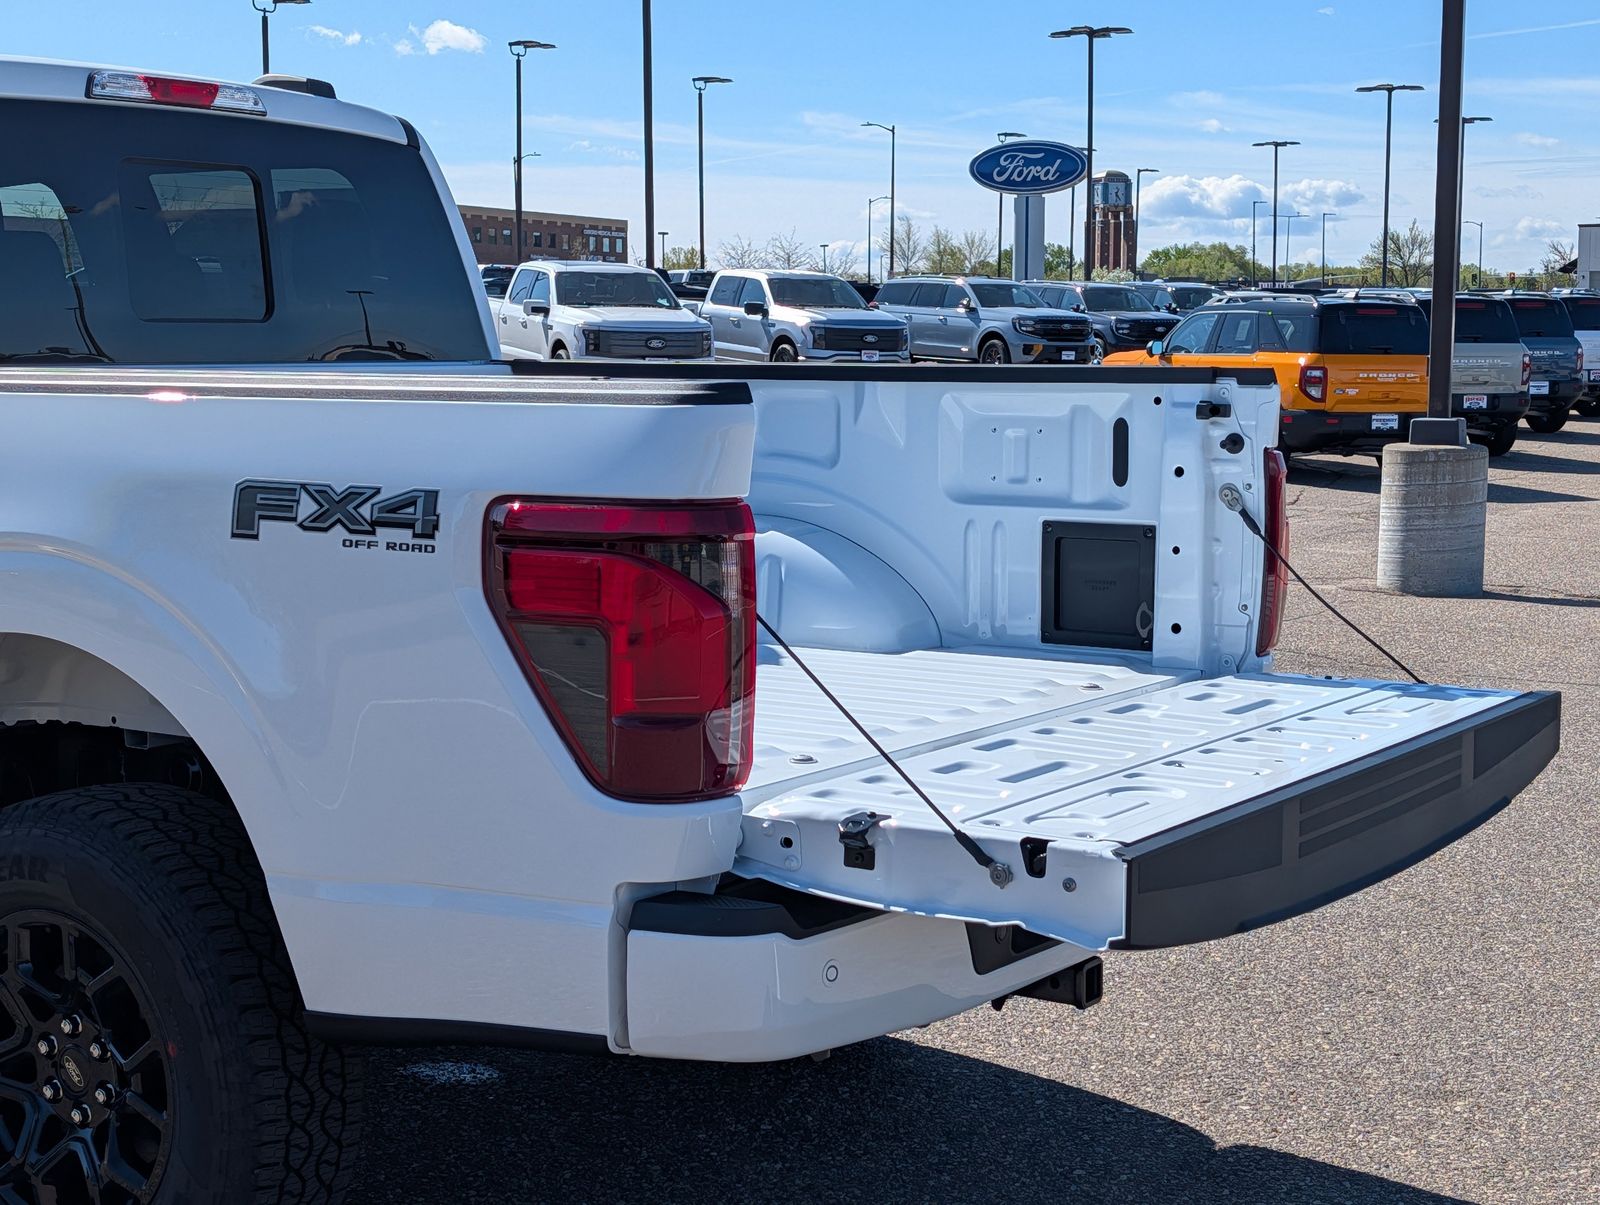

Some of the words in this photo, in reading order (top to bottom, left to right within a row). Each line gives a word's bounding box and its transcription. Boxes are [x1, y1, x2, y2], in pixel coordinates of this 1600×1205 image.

[993, 152, 1063, 182] Ford
[231, 477, 440, 539] FX4
[342, 539, 378, 550] OFF
[385, 541, 436, 554] ROAD
